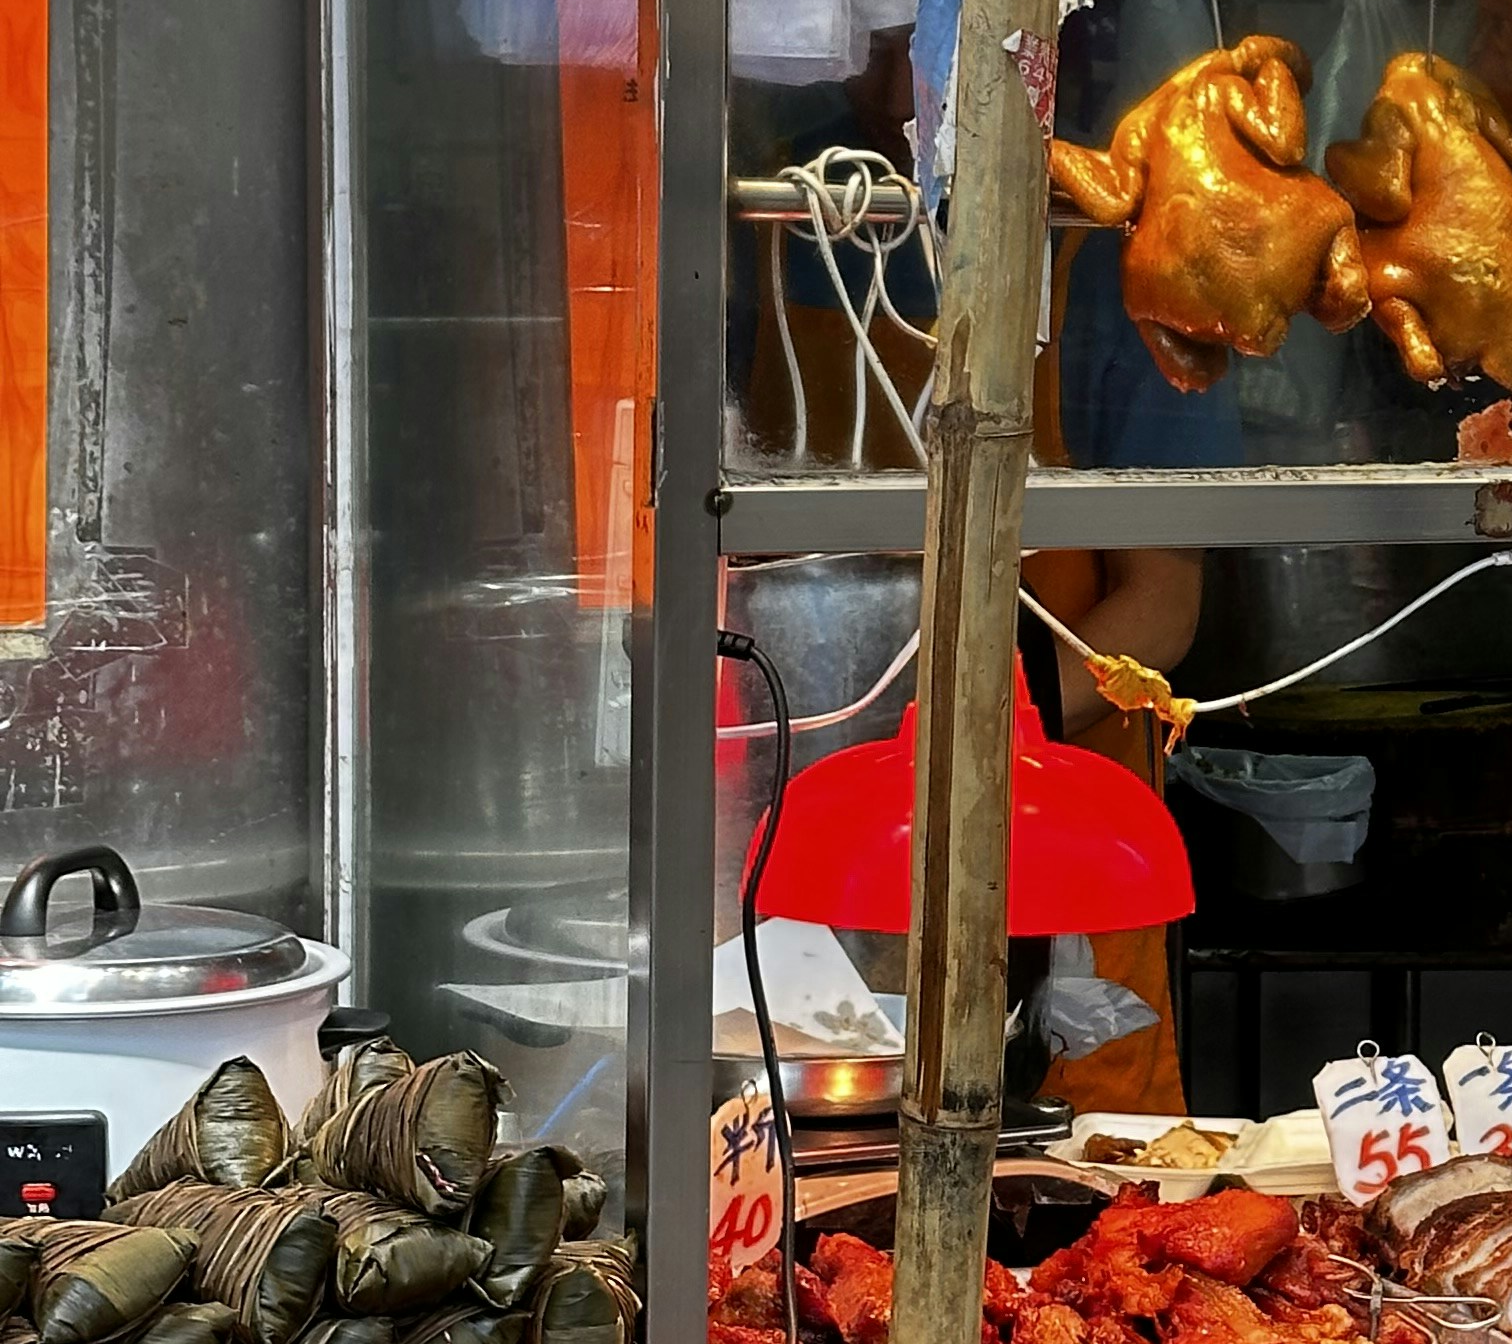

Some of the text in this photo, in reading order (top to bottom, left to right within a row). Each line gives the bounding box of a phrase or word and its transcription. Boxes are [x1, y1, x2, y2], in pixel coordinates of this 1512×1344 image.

[1330, 1060, 1436, 1120] 二条
[1353, 1122, 1432, 1195] 55
[711, 1193, 774, 1257] 40
